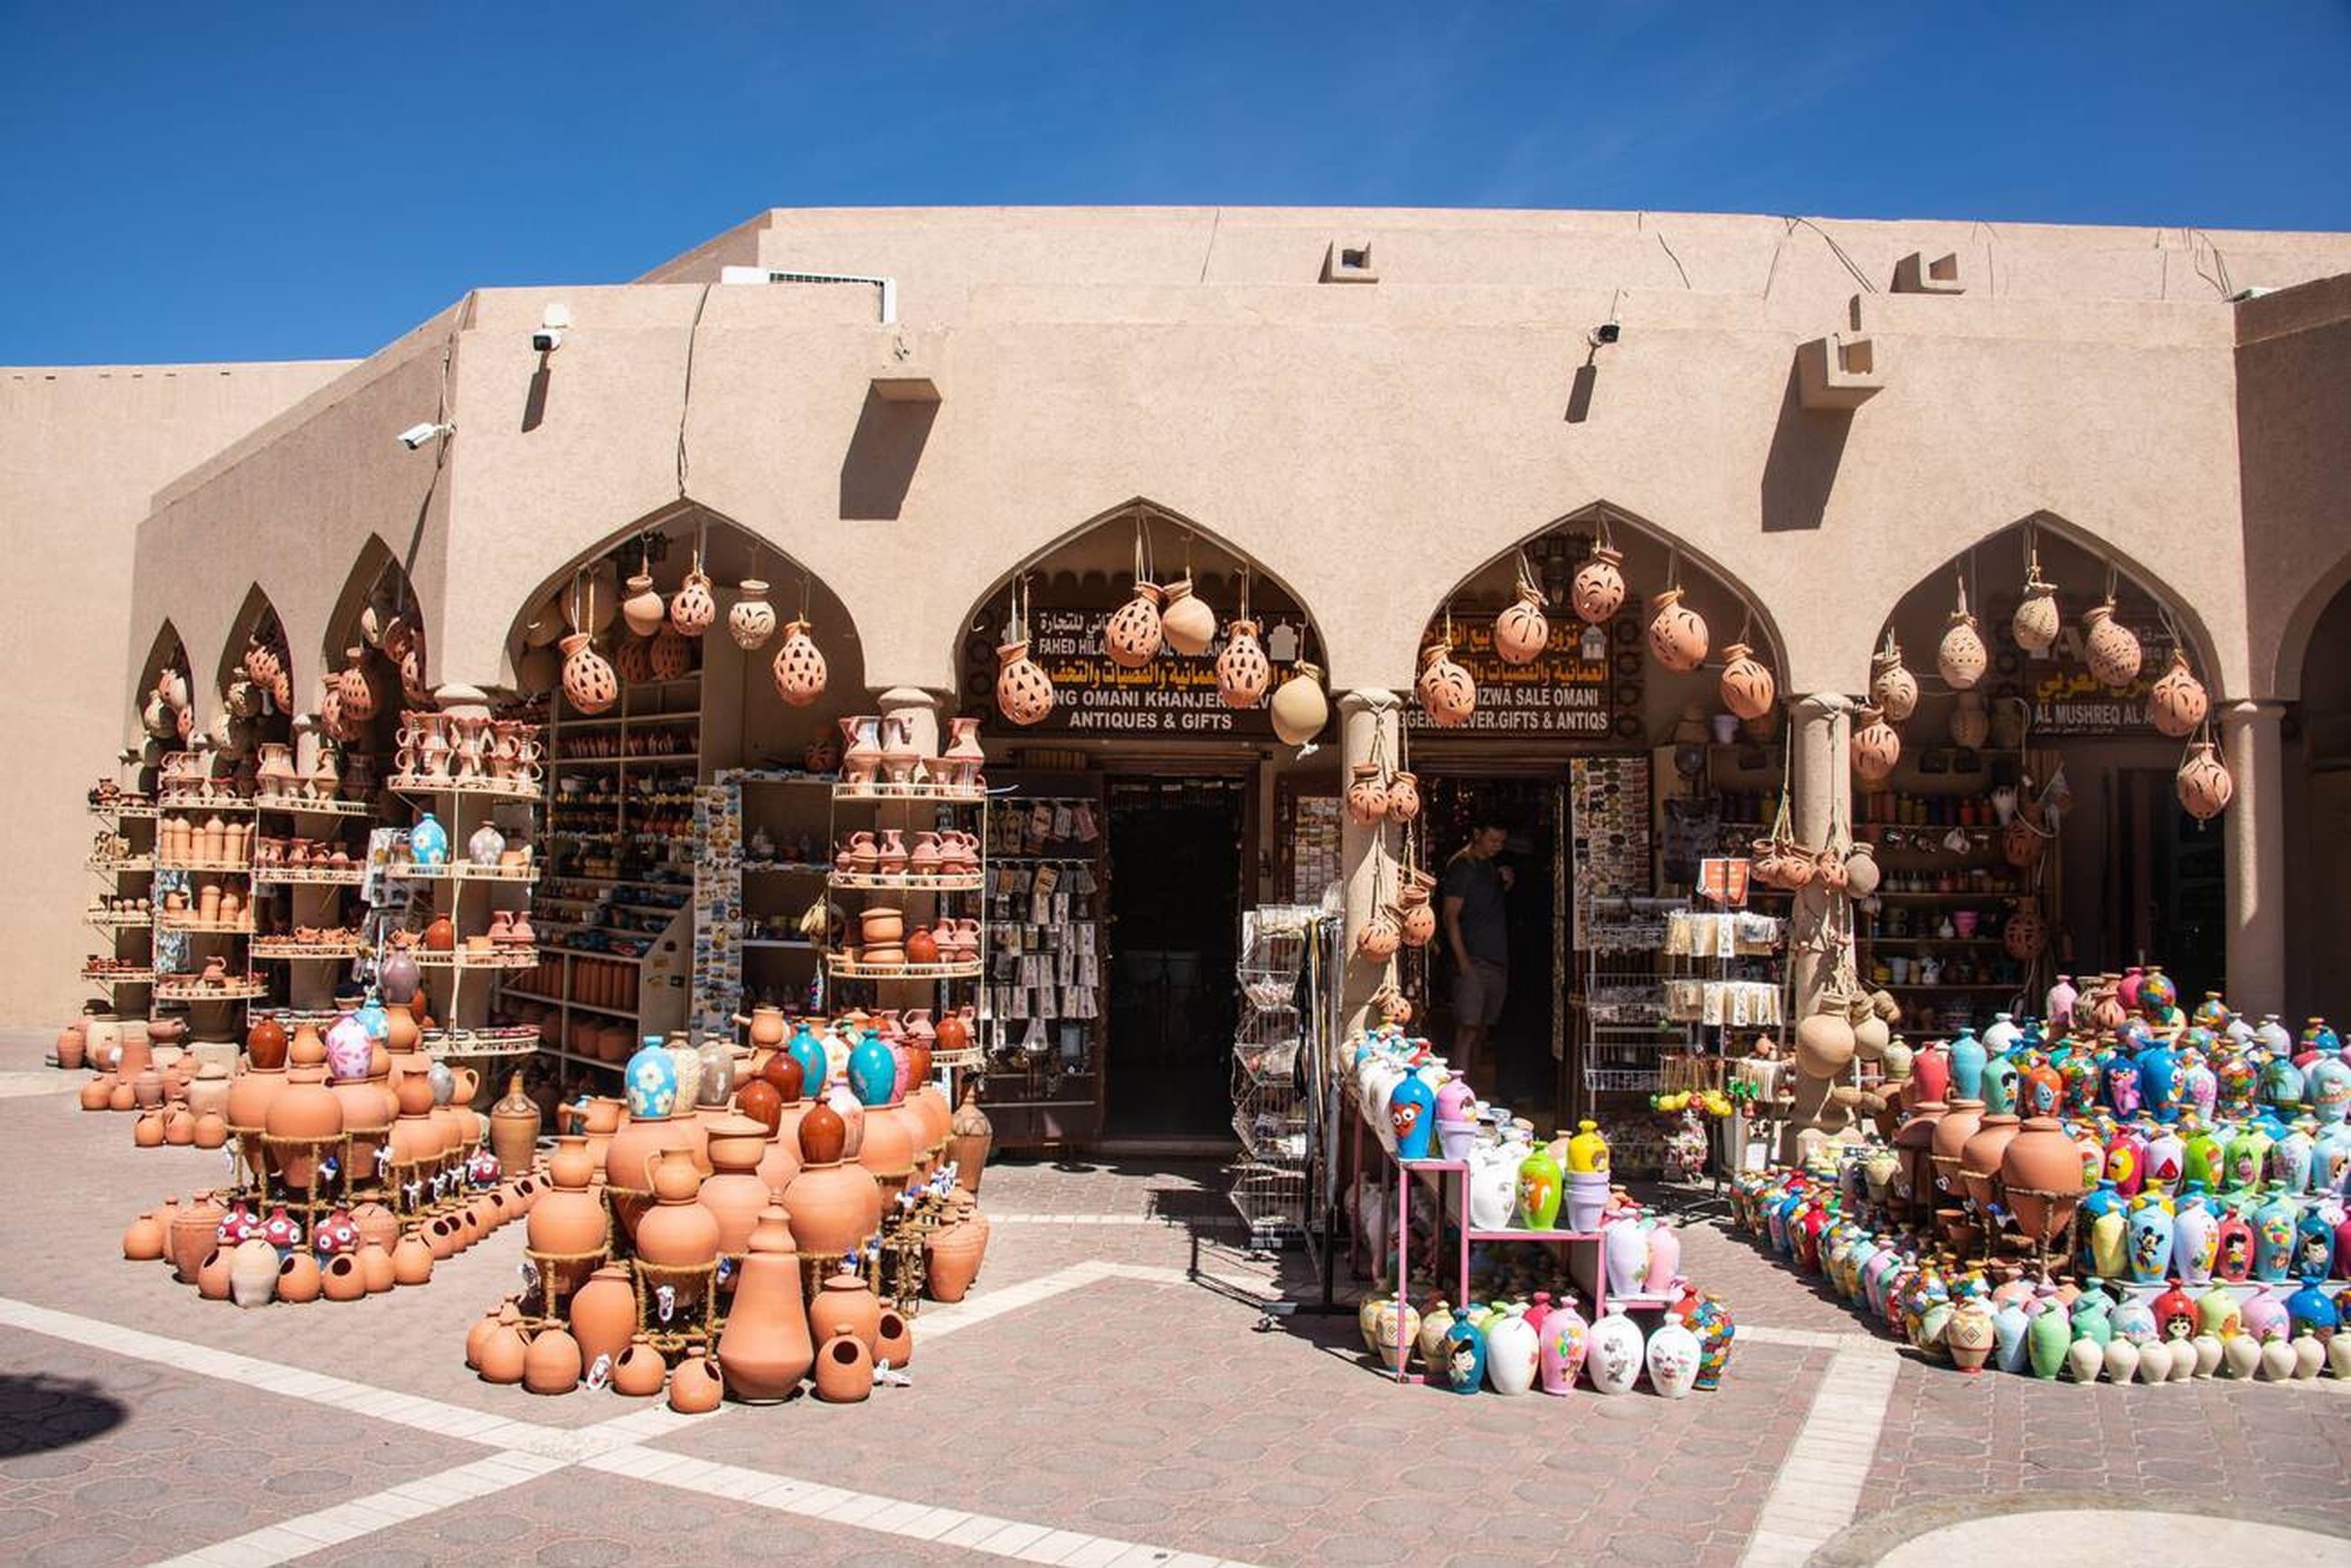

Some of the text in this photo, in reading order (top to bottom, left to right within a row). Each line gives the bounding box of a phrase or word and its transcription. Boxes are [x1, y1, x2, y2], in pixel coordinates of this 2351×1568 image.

[1039, 638, 1076, 655] FAHED
[1079, 638, 1108, 656] HILA
[1083, 690, 1139, 707] OMANI
[1477, 687, 1599, 706] IZWA SALE OMANI
[1070, 711, 1232, 730] ANTIQUES & GIFTS
[1542, 711, 1553, 729] &
[1556, 711, 1608, 730] ANTIQS
[2035, 704, 2053, 723] AL
[2054, 704, 2120, 724] MUSHREQ
[2124, 704, 2142, 723] AL
